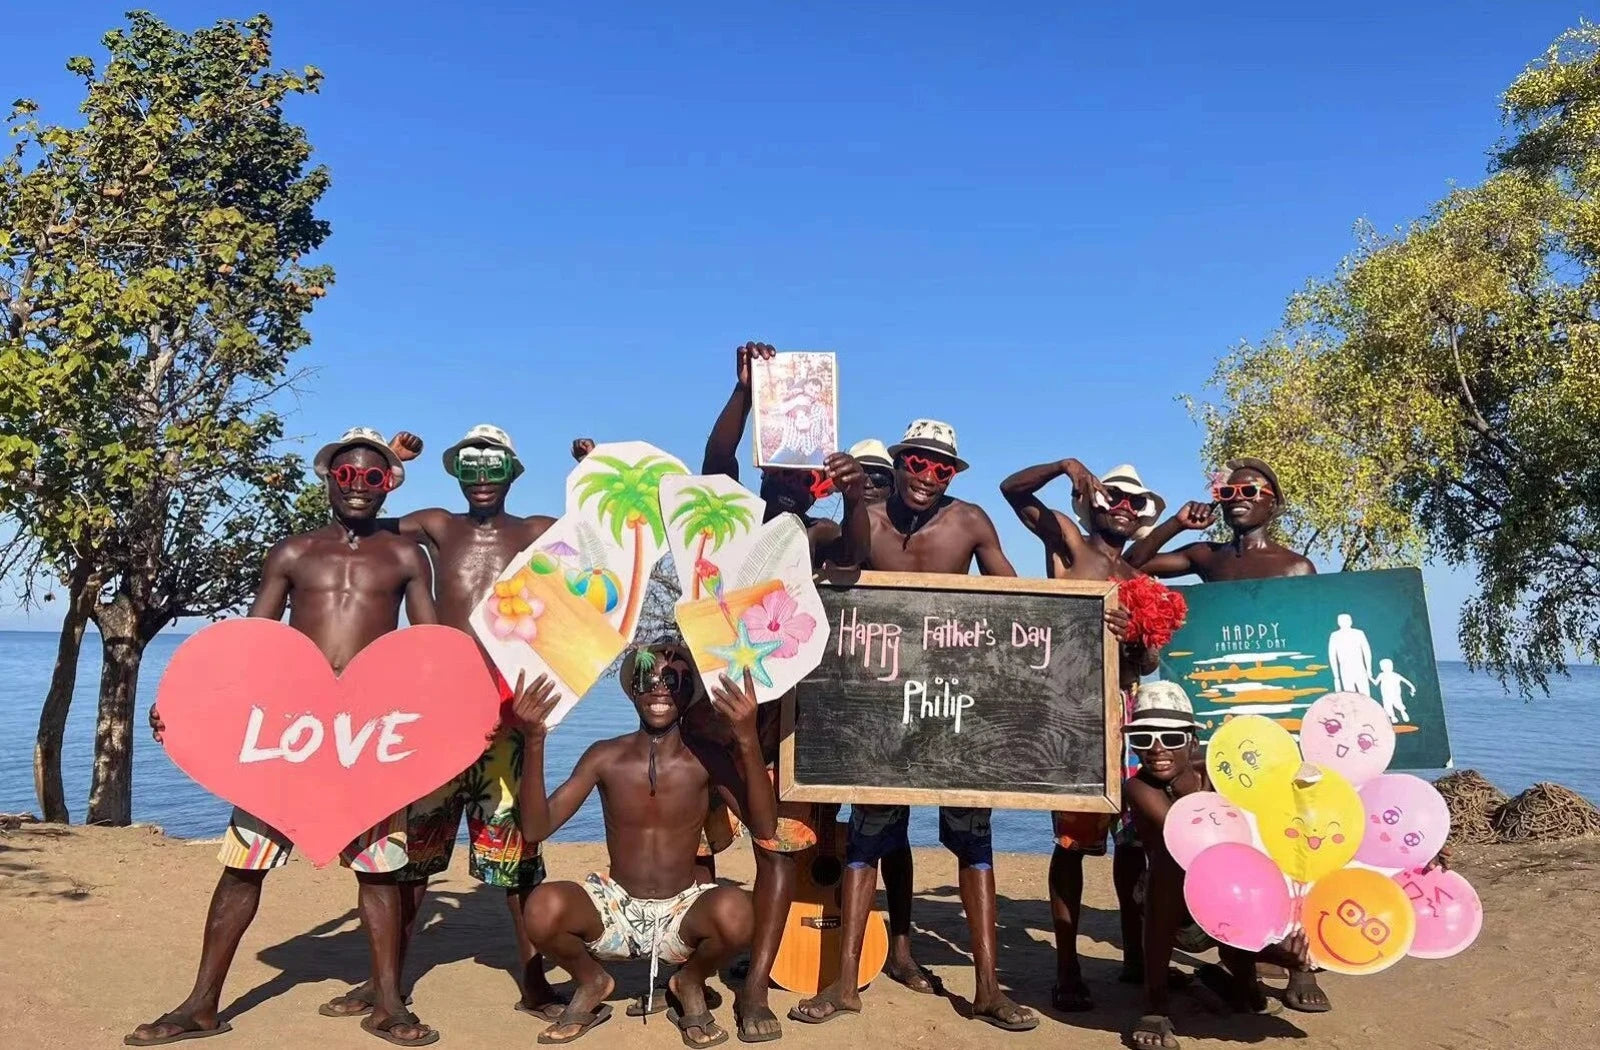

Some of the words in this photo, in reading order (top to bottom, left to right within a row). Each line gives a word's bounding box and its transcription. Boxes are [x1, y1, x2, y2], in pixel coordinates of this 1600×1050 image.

[838, 607, 902, 681] Happy
[922, 616, 996, 650] Father's
[1011, 619, 1052, 669] Day
[1215, 640, 1261, 652] FATHER'S
[1266, 638, 1286, 649] DAY
[1222, 622, 1280, 642] HAPPY
[902, 676, 975, 734] Philip
[239, 704, 423, 768] LOVE
